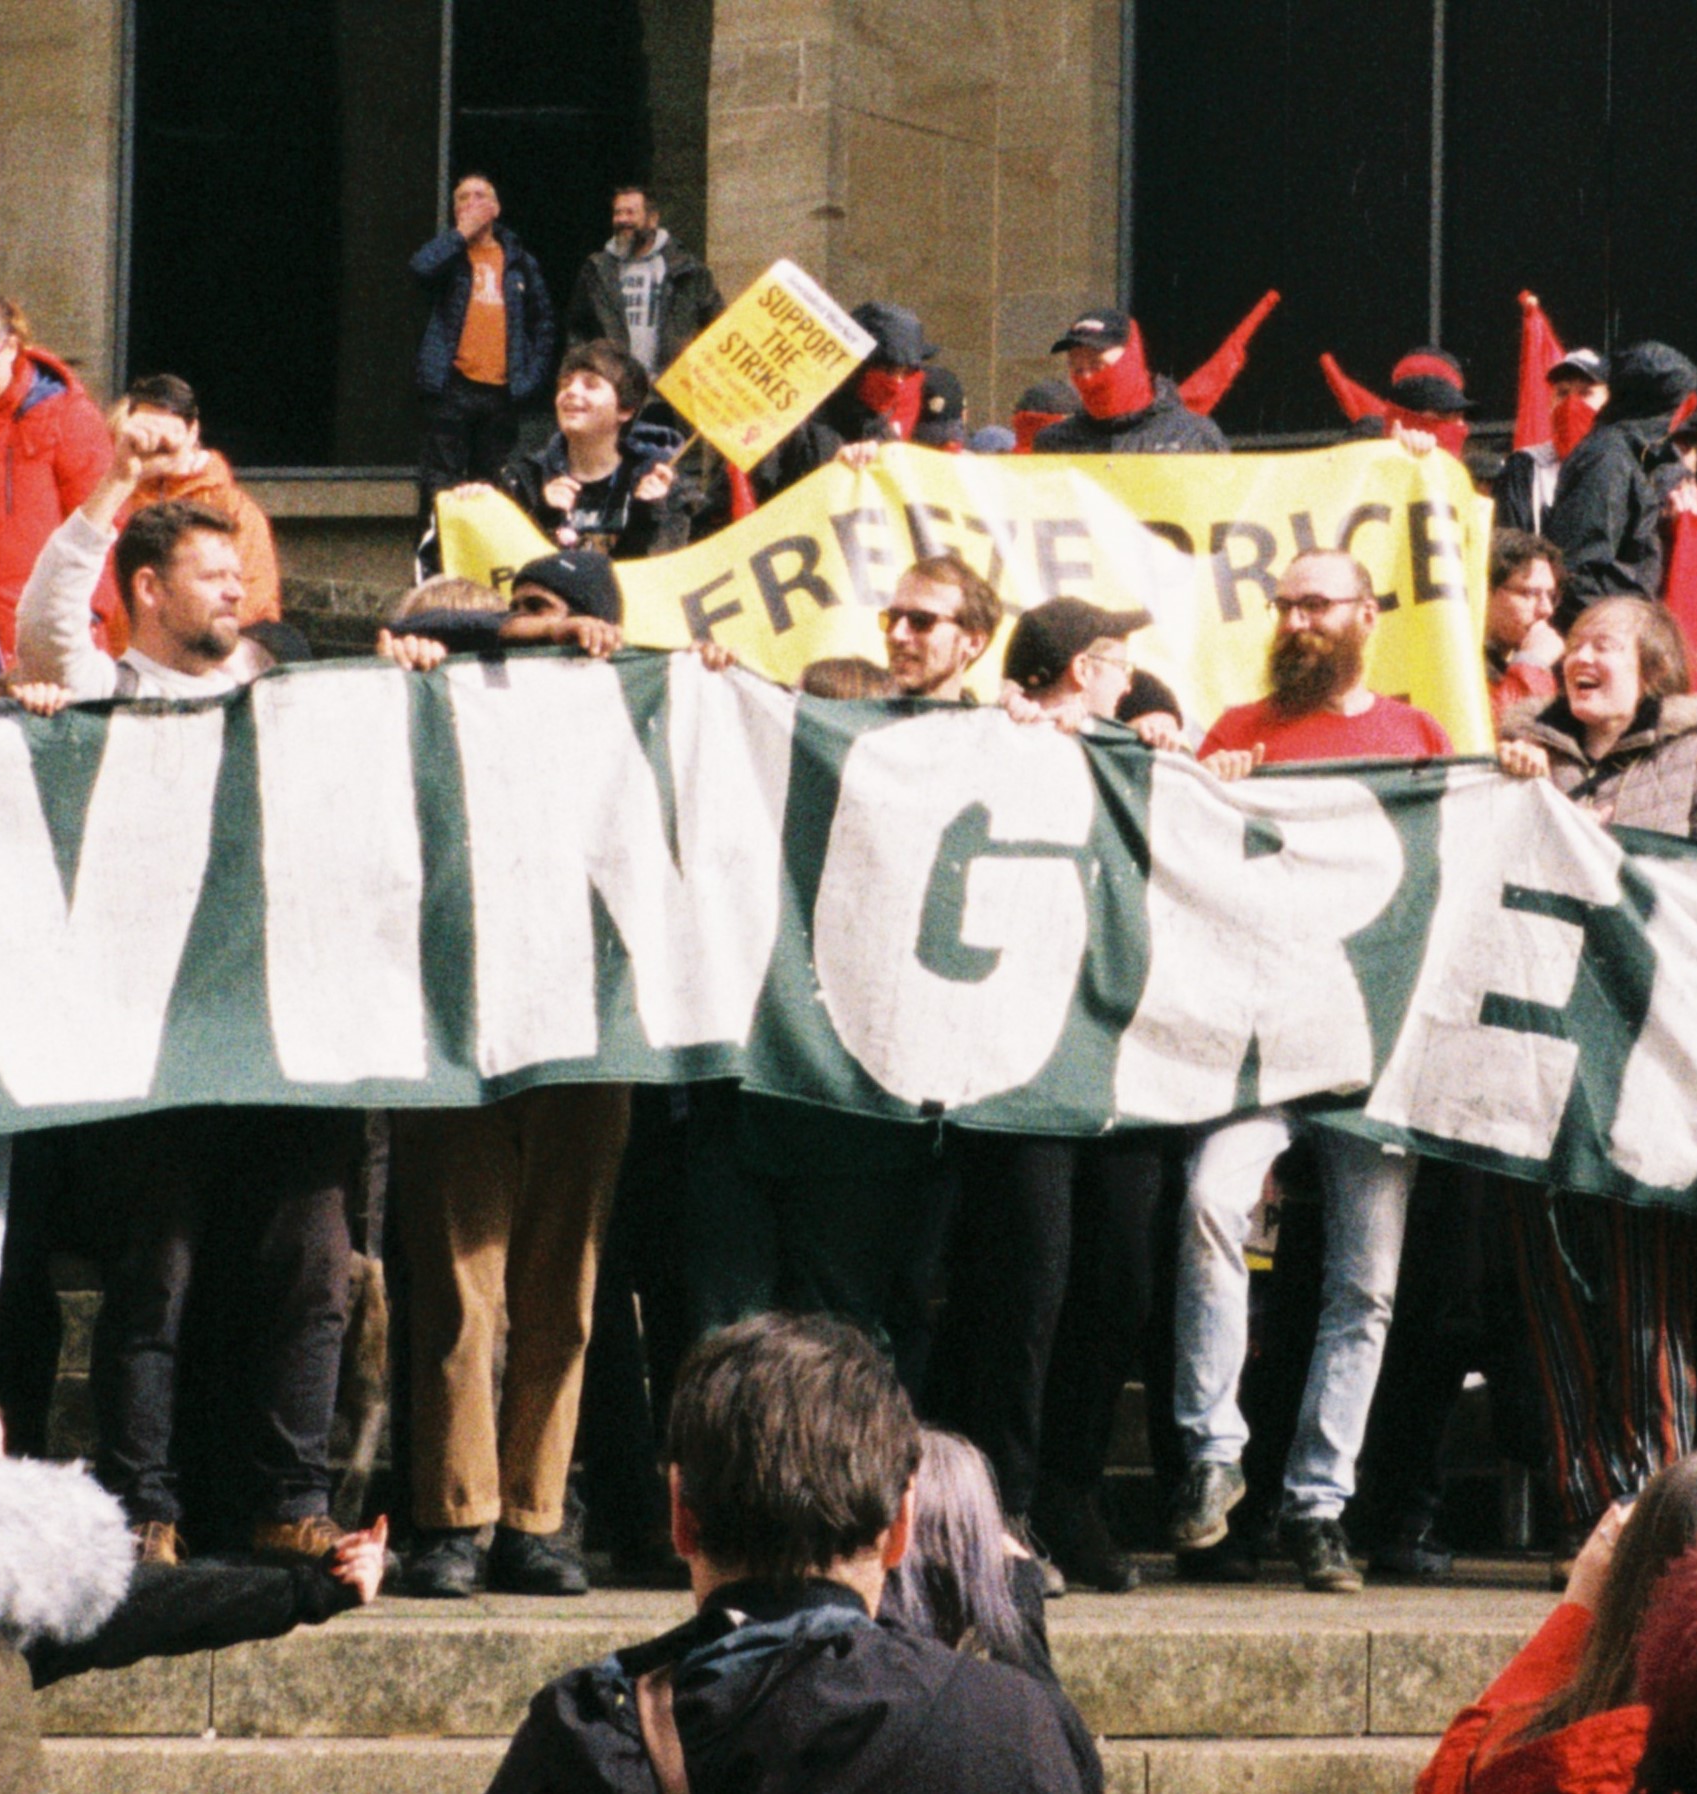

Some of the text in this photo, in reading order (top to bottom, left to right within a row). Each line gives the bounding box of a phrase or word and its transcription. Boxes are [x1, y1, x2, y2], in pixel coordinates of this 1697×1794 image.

[758, 284, 850, 371] SUPPORT
[759, 326, 808, 373] THE
[717, 330, 801, 412] STRIKES
